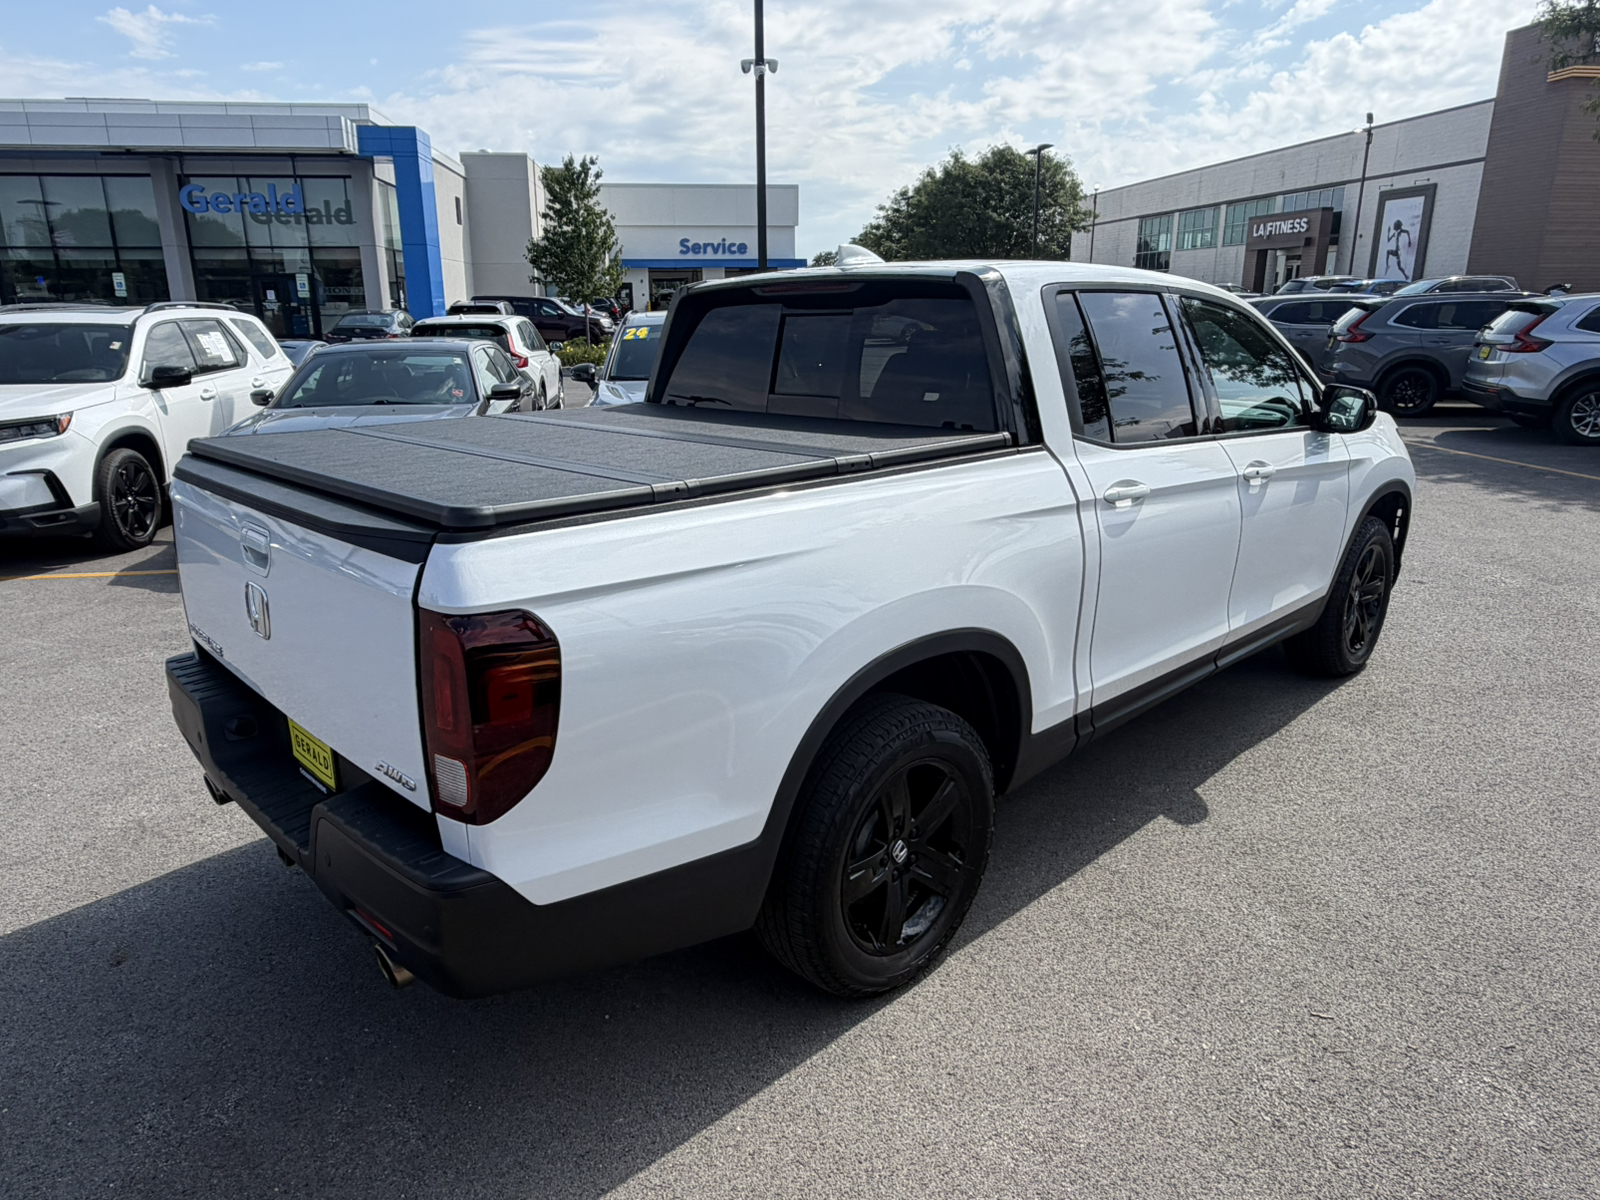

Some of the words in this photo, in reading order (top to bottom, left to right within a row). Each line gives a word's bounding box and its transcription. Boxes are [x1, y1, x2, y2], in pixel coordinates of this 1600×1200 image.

[179, 182, 304, 214] Gerald
[1253, 223, 1264, 237] LA
[1267, 217, 1309, 236] FITNESS
[679, 238, 748, 255] Service
[623, 326, 649, 341] 24
[295, 733, 329, 770] GERALD
[375, 759, 417, 792] AWD
